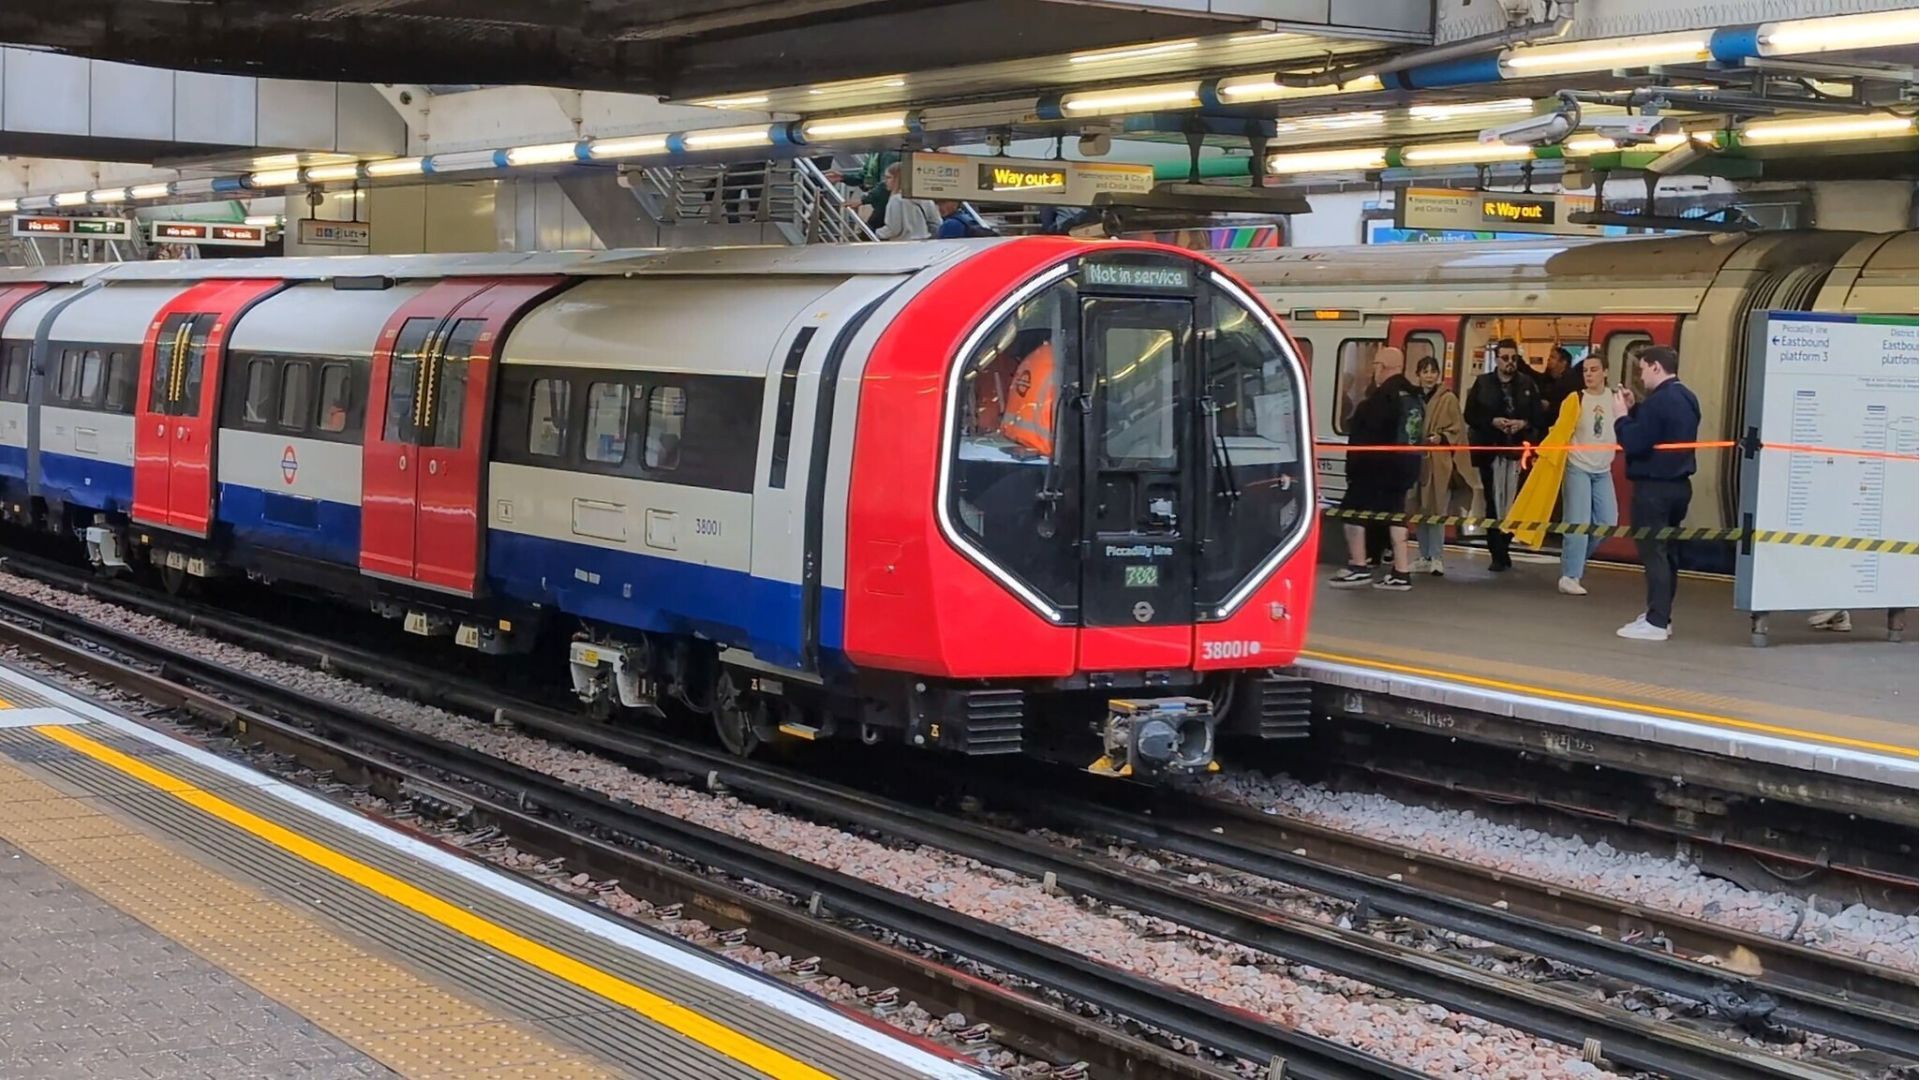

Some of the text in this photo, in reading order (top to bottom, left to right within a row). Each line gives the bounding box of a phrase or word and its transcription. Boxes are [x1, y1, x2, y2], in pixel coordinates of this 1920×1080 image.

[994, 168, 1049, 187] Way out
[1497, 202, 1542, 219] Way out
[28, 221, 60, 231] No exit
[167, 227, 197, 236] No exit
[222, 229, 252, 239] No exit
[1090, 264, 1183, 285] Not in service
[1782, 324, 1828, 334] Piccadilly line
[1891, 328, 1914, 337] District
[1781, 335, 1830, 348] Eastbound
[1883, 339, 1919, 351] Eastbou
[1780, 350, 1829, 362] platform 3
[695, 518, 722, 537] 38001
[1106, 545, 1173, 557] Piccadilly line
[1202, 640, 1249, 660] 38001
